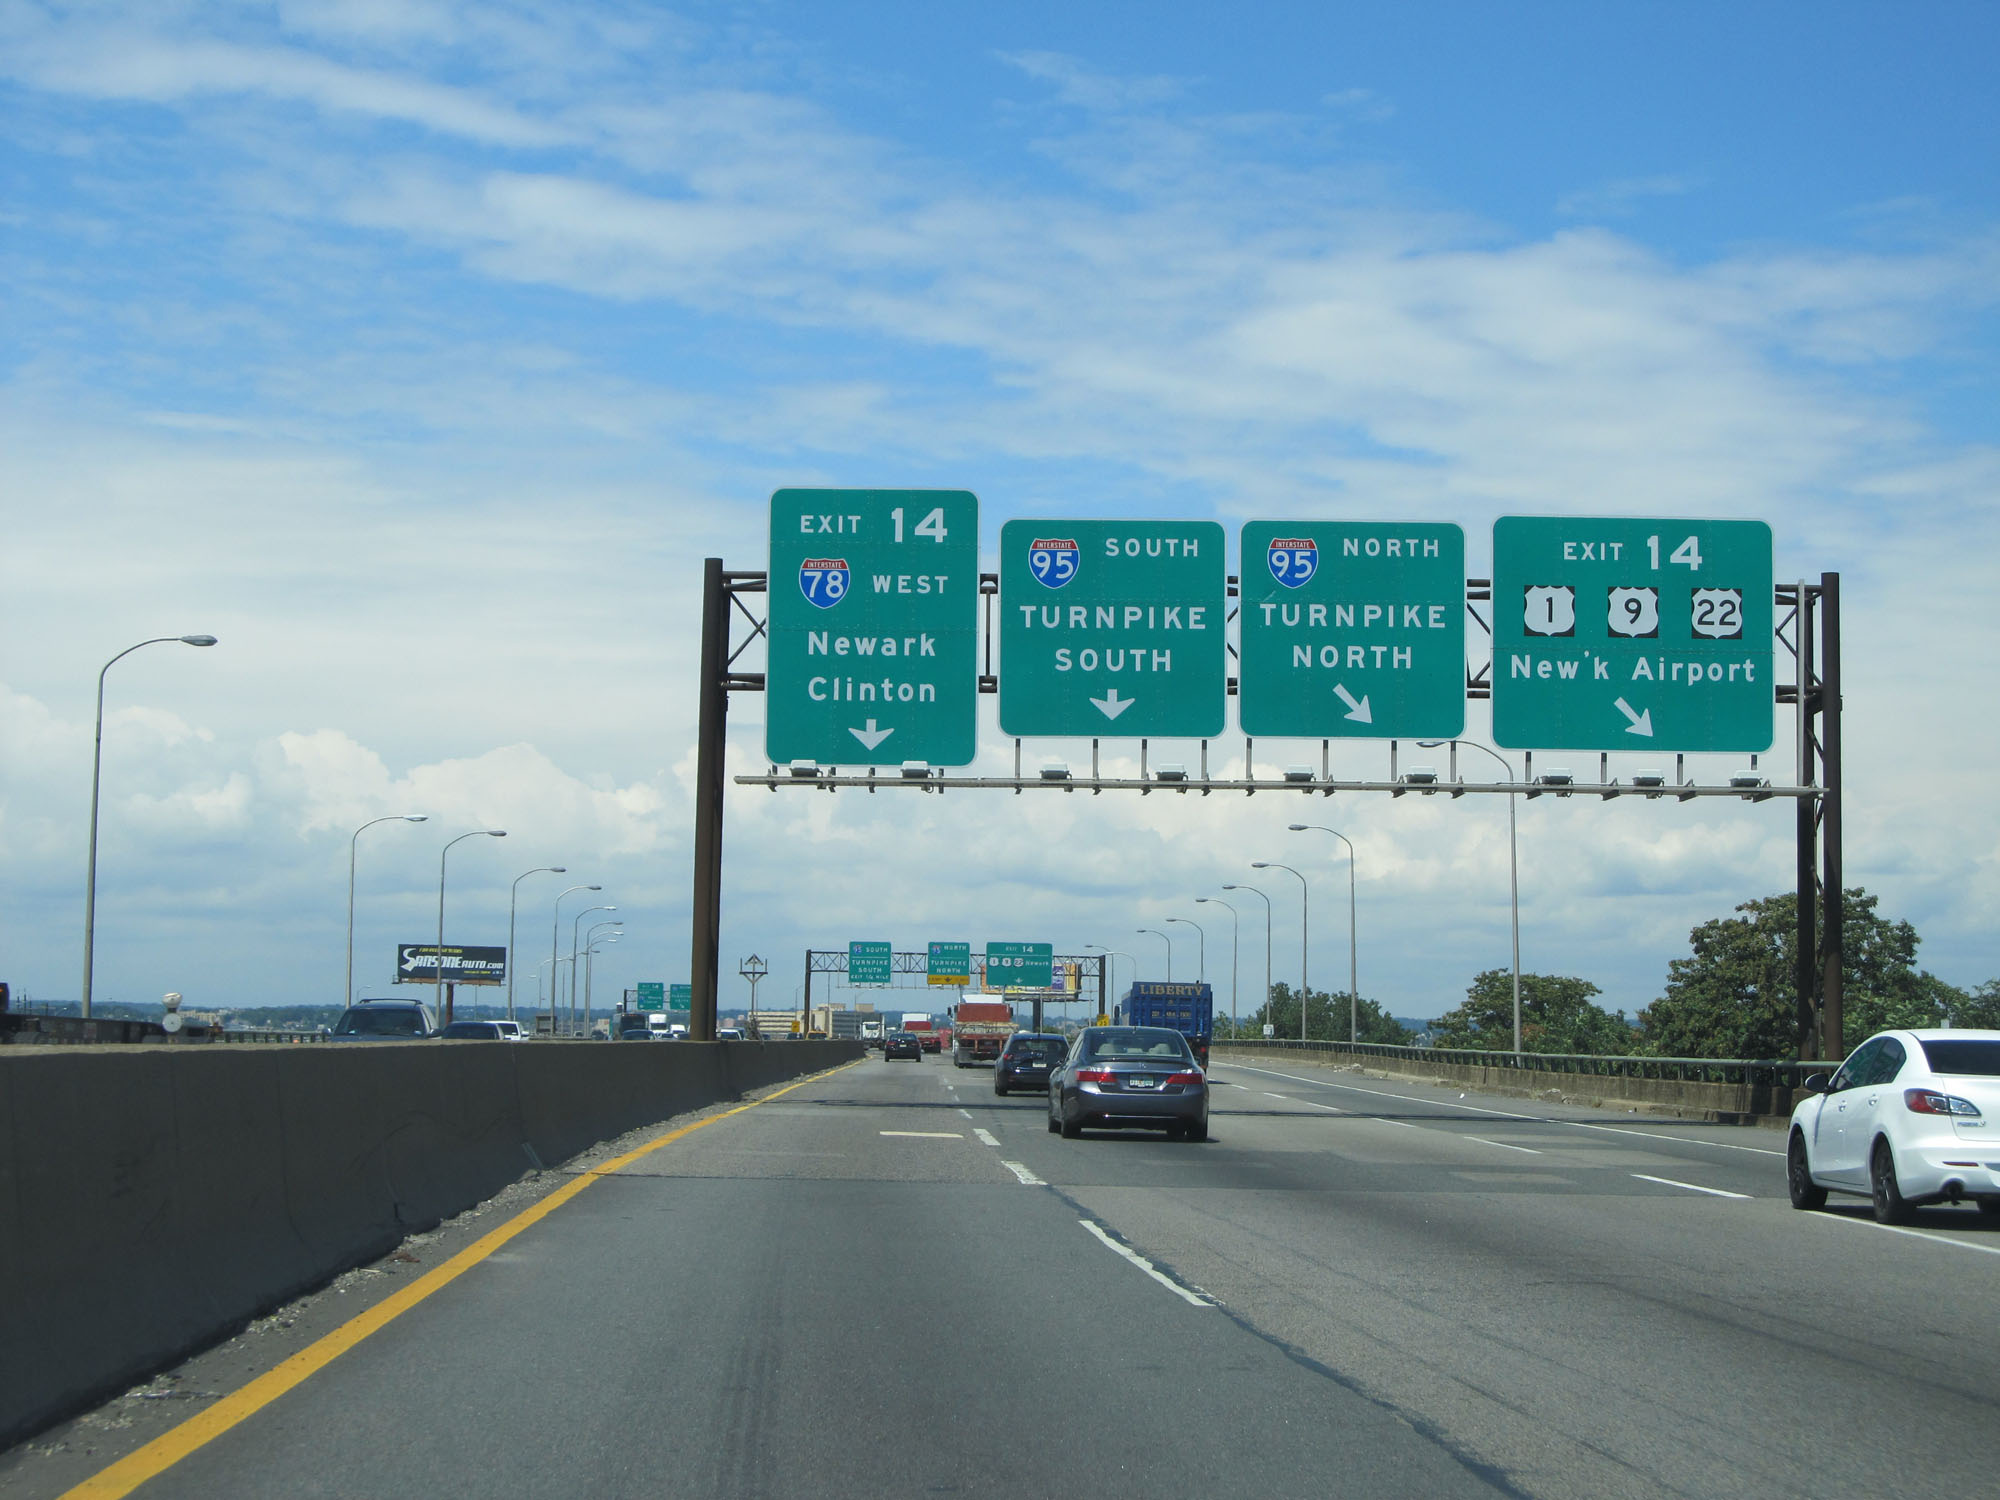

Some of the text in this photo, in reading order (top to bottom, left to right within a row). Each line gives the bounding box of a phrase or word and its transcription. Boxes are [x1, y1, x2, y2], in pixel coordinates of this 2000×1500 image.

[800, 507, 948, 543] EXIT 14
[1036, 541, 1073, 550] INTERSTATE
[1104, 538, 1199, 558] SOUTH
[1275, 540, 1312, 549] INTERSTATE
[1342, 538, 1439, 558] NORTH
[1563, 535, 1703, 571] EXIT 14
[807, 560, 844, 569] INTERSTATE
[1032, 551, 1075, 580] 95
[1271, 550, 1313, 579] 95
[804, 571, 845, 599] 78
[872, 575, 948, 594] WEST
[1019, 605, 1207, 631] TURNPIKE
[1259, 603, 1446, 629] TURNPIKE
[1545, 596, 1555, 624] 1
[1623, 597, 1643, 625] 9
[1697, 598, 1739, 627] 22
[808, 631, 936, 657] Newark
[1293, 644, 1412, 670] NORTH
[1055, 648, 1172, 672] SOUTH
[1510, 650, 1756, 687] New'k Airport
[808, 677, 936, 702] Clinton
[1022, 945, 1034, 953] 14
[1140, 984, 1204, 996] LIBERTY
